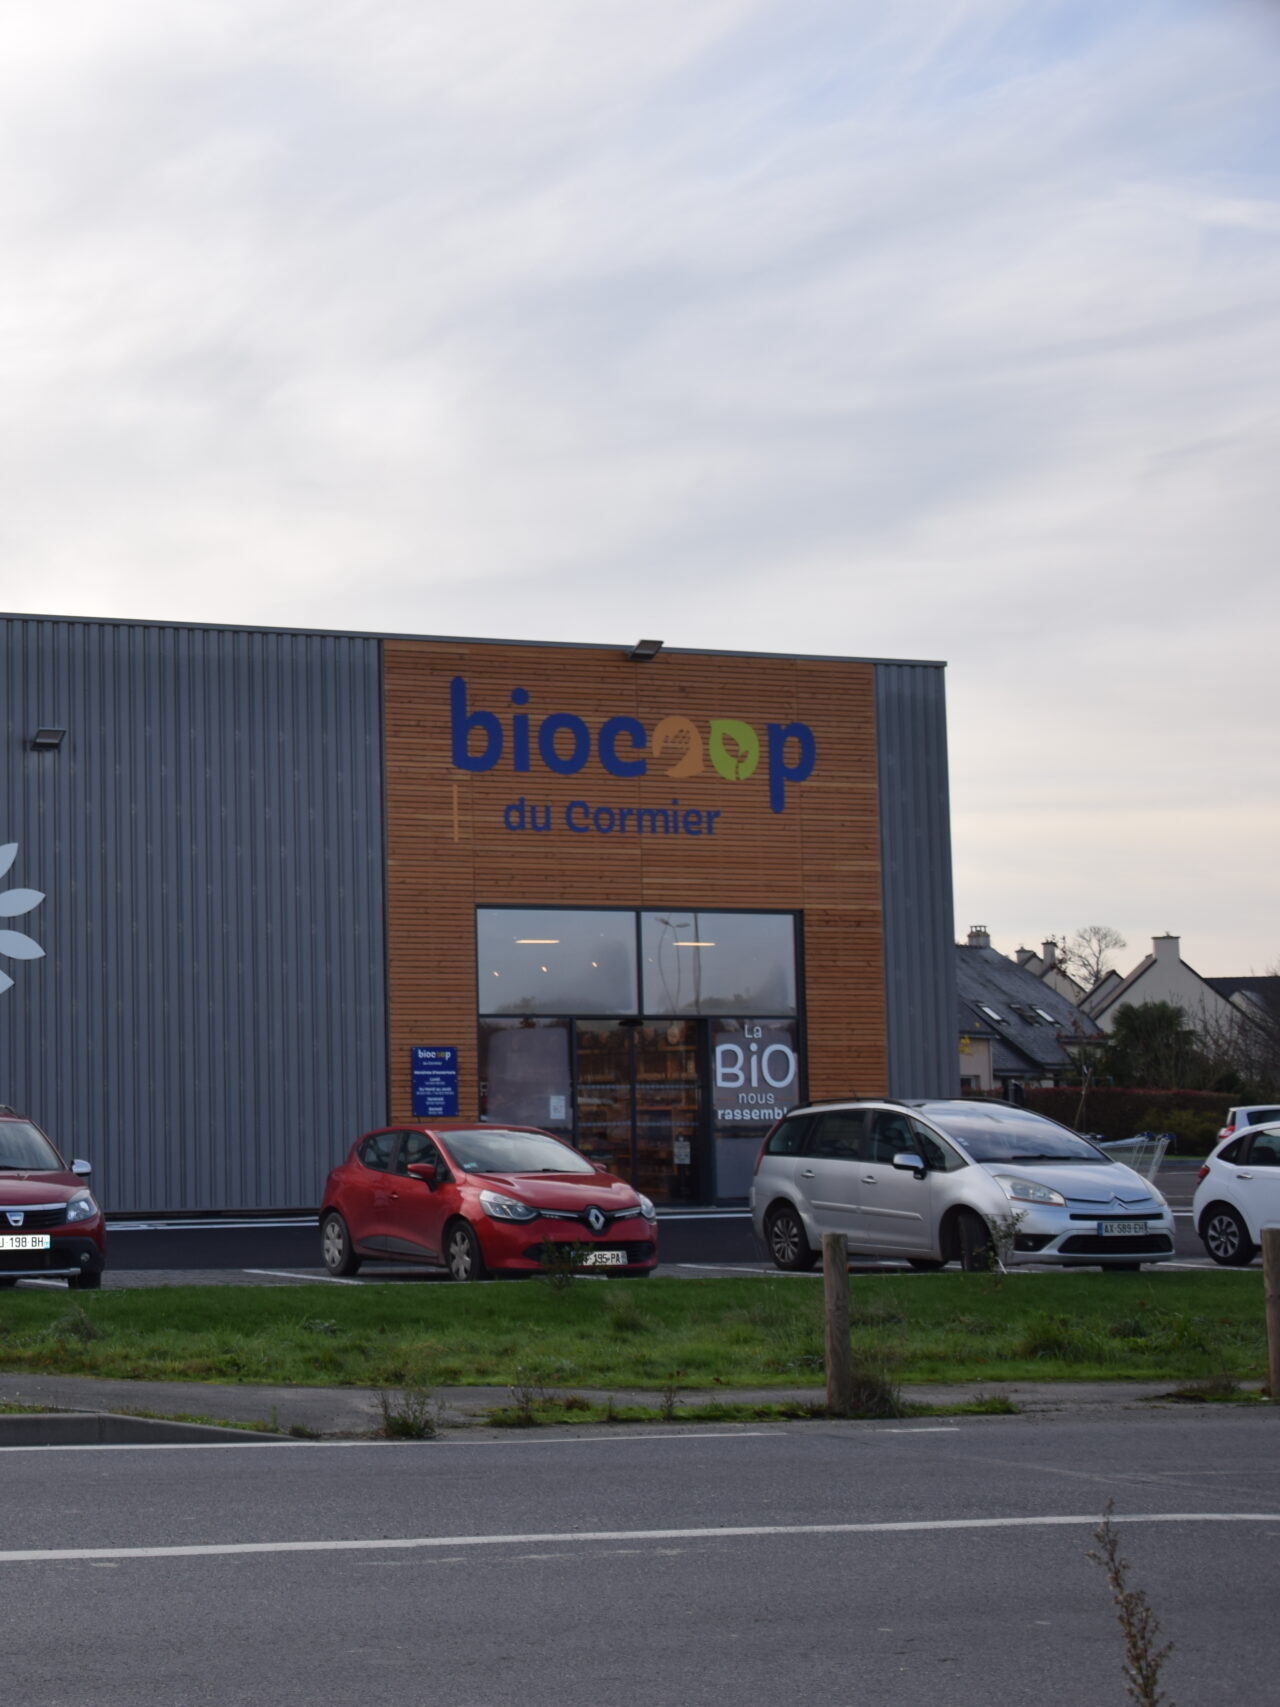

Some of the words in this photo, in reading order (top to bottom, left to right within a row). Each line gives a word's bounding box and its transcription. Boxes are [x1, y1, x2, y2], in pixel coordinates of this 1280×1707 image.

[450, 675, 817, 814] biocoop
[503, 797, 552, 832] du
[565, 799, 721, 837] Cormier
[744, 1024, 762, 1039] La
[715, 1042, 796, 1089] BiO
[738, 1092, 775, 1104] nous
[717, 1107, 788, 1120] rassembl
